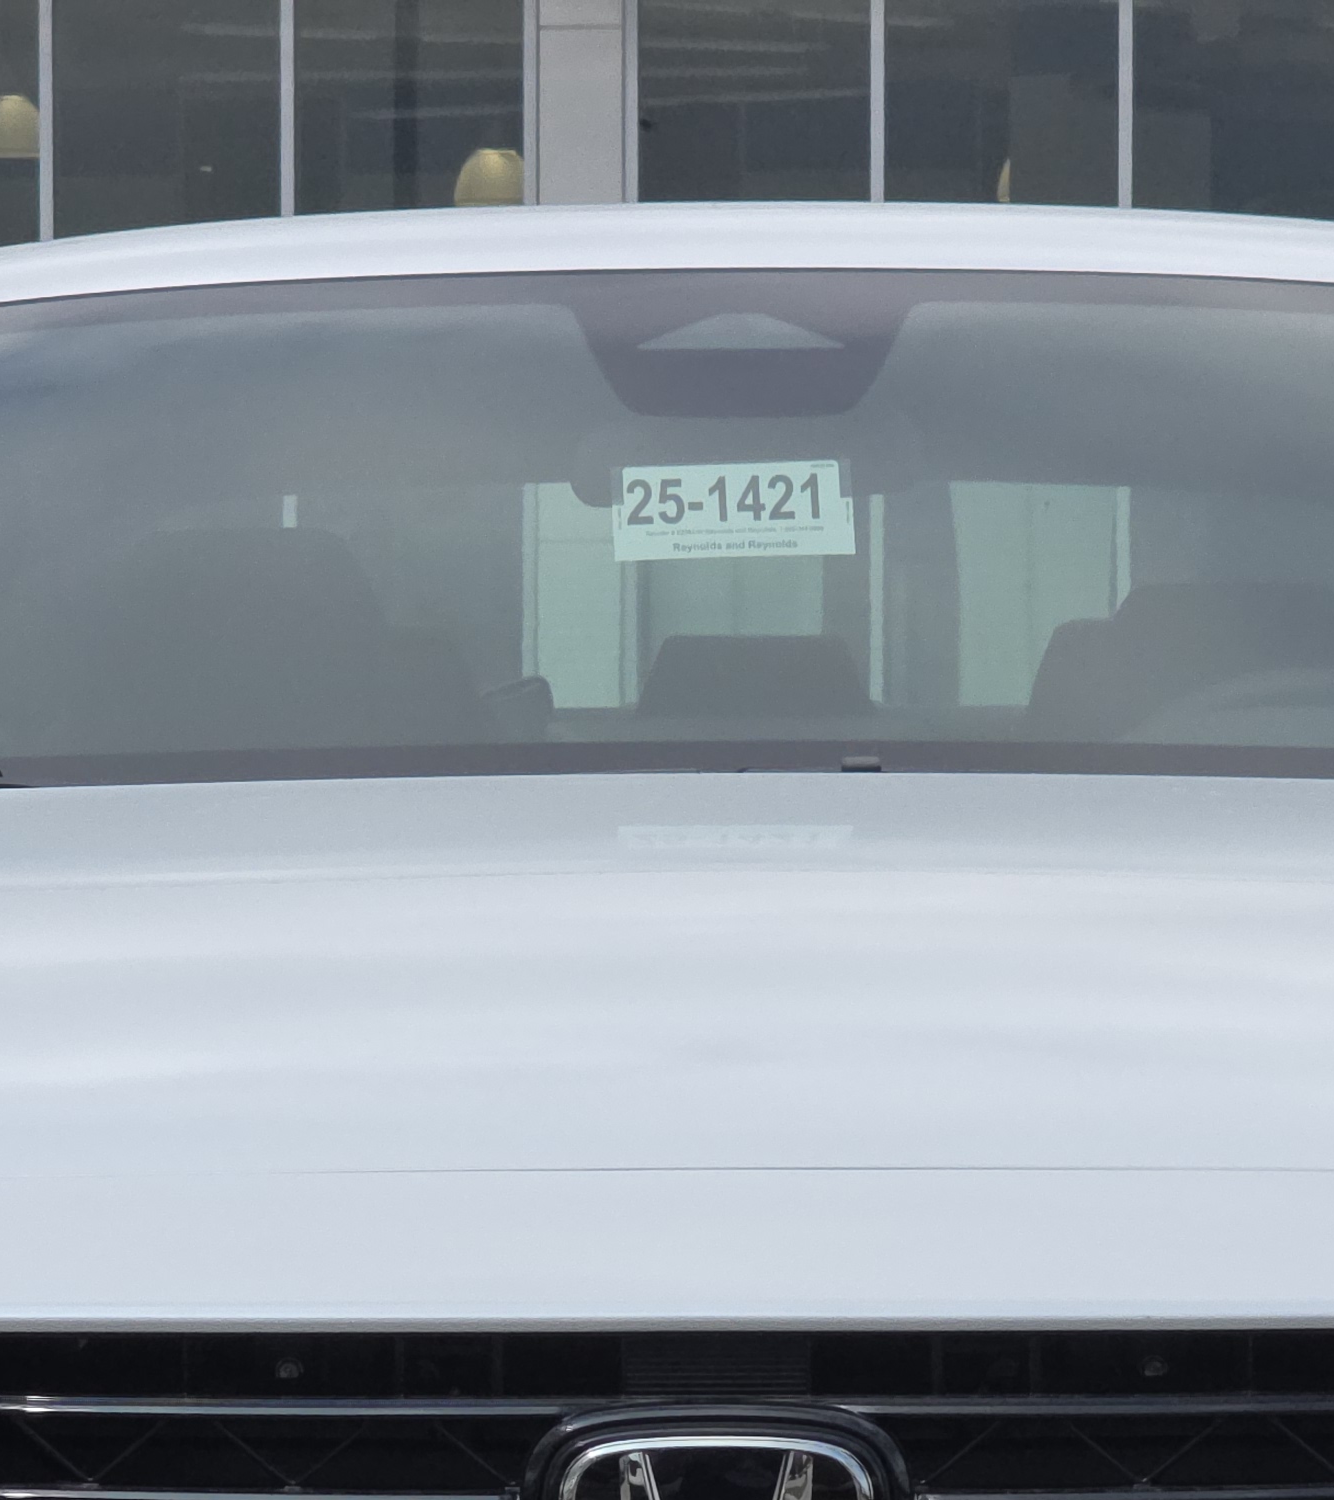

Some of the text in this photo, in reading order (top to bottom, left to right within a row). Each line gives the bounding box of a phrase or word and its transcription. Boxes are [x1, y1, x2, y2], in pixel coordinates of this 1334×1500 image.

[626, 473, 821, 526] 25-1421
[672, 539, 798, 553] Reynolds and Reynolds
